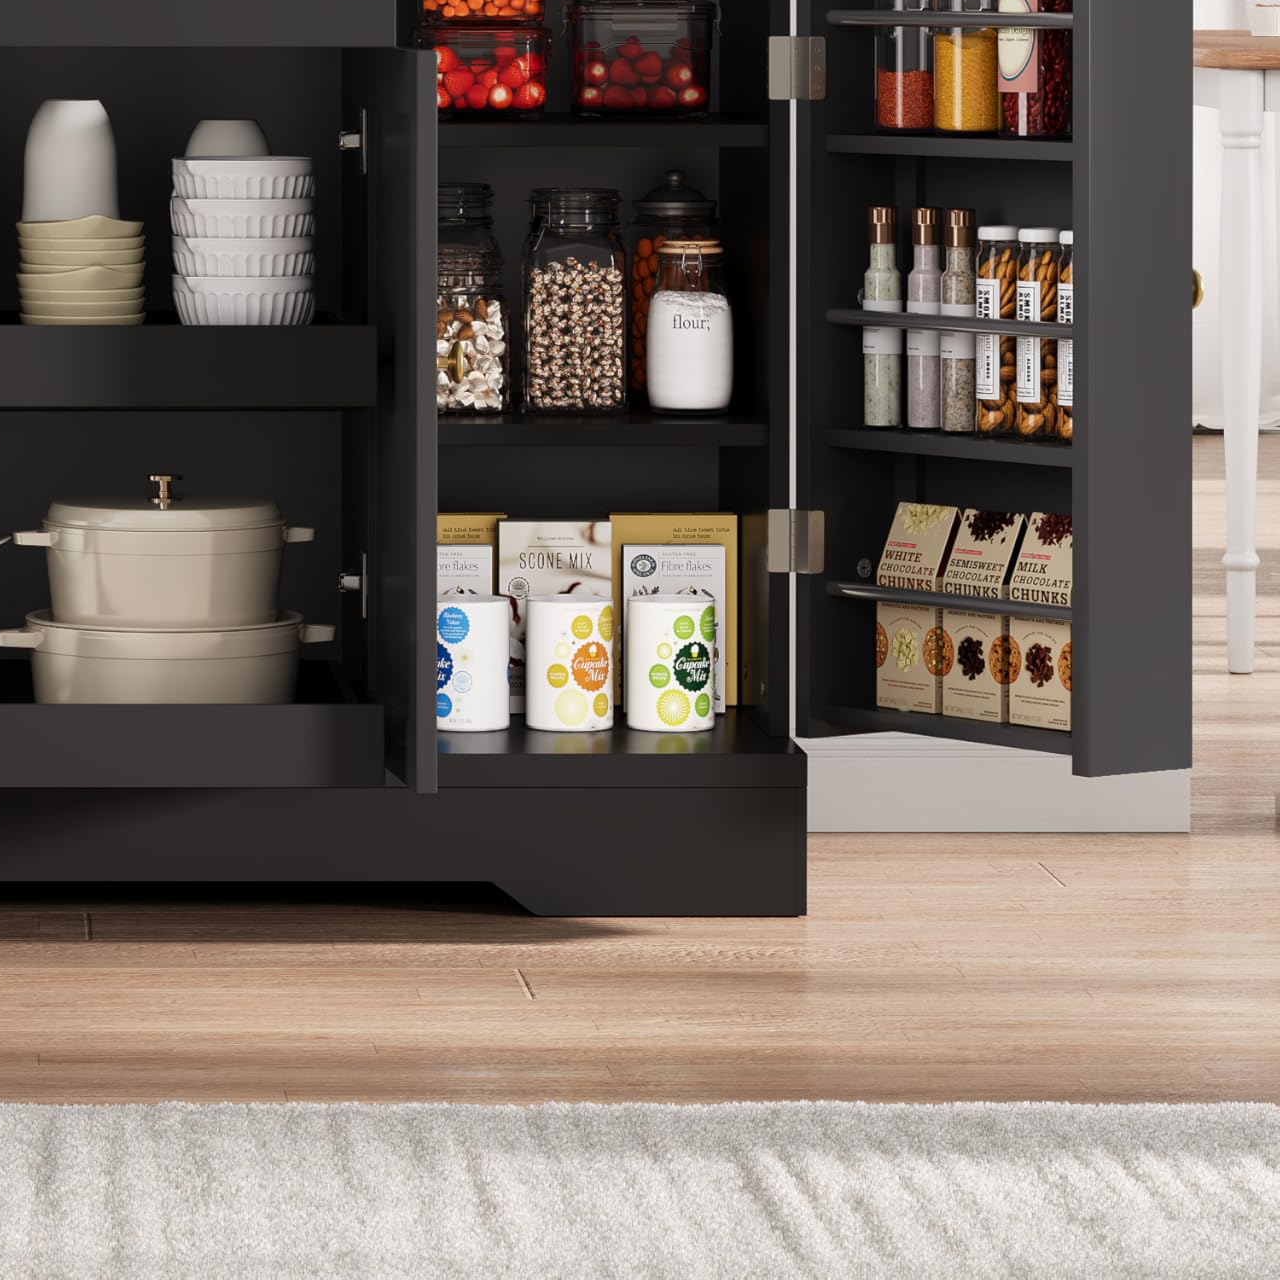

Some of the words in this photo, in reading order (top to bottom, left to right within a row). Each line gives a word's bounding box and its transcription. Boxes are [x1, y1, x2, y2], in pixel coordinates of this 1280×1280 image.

[519, 552, 562, 569] SCONE
[569, 552, 592, 569] MIX
[885, 550, 922, 562] WHITE
[453, 560, 479, 571] flakes
[661, 560, 684, 571] Fibre
[686, 560, 712, 571] flakes
[880, 563, 935, 576] CHOCOLATE
[950, 559, 1005, 572] SEMISWEET
[1017, 562, 1048, 574] MILK
[946, 570, 1001, 583] CHOCOLATE
[1013, 575, 1070, 588] CHOCOLATE
[879, 575, 932, 592] CHUNKS
[945, 582, 998, 599] CHUNKS
[1012, 587, 1068, 605] CHUNKS
[573, 657, 608, 672] Cupcake
[675, 656, 710, 673] Cupcake
[585, 669, 605, 682] Mix
[686, 670, 706, 682] Mix
